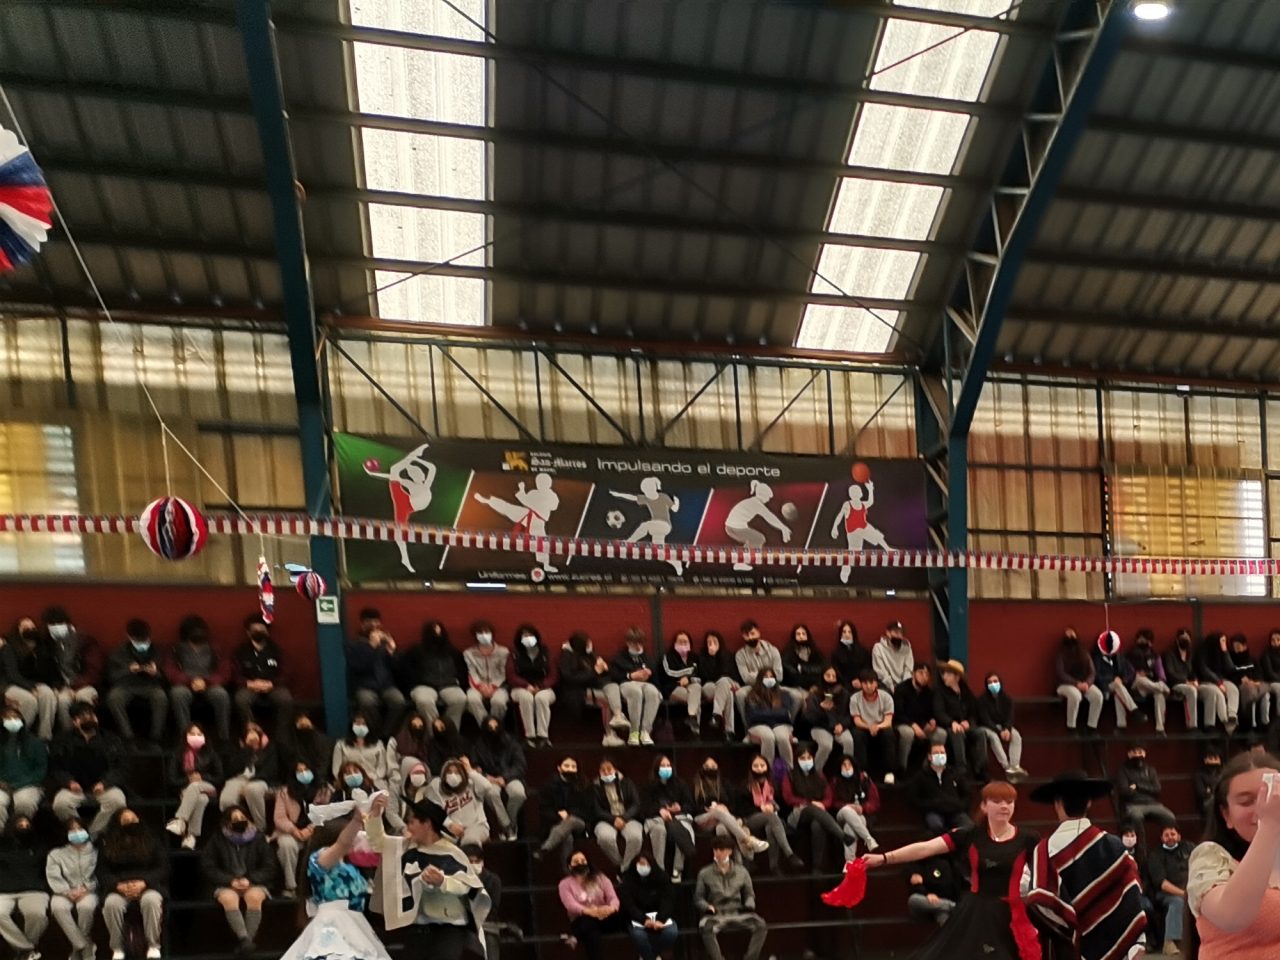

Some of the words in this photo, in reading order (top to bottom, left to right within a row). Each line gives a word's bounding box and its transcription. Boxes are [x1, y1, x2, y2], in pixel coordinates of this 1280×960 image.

[597, 458, 692, 473] Impulsando
[697, 462, 711, 474] el
[716, 463, 781, 478] deporte
